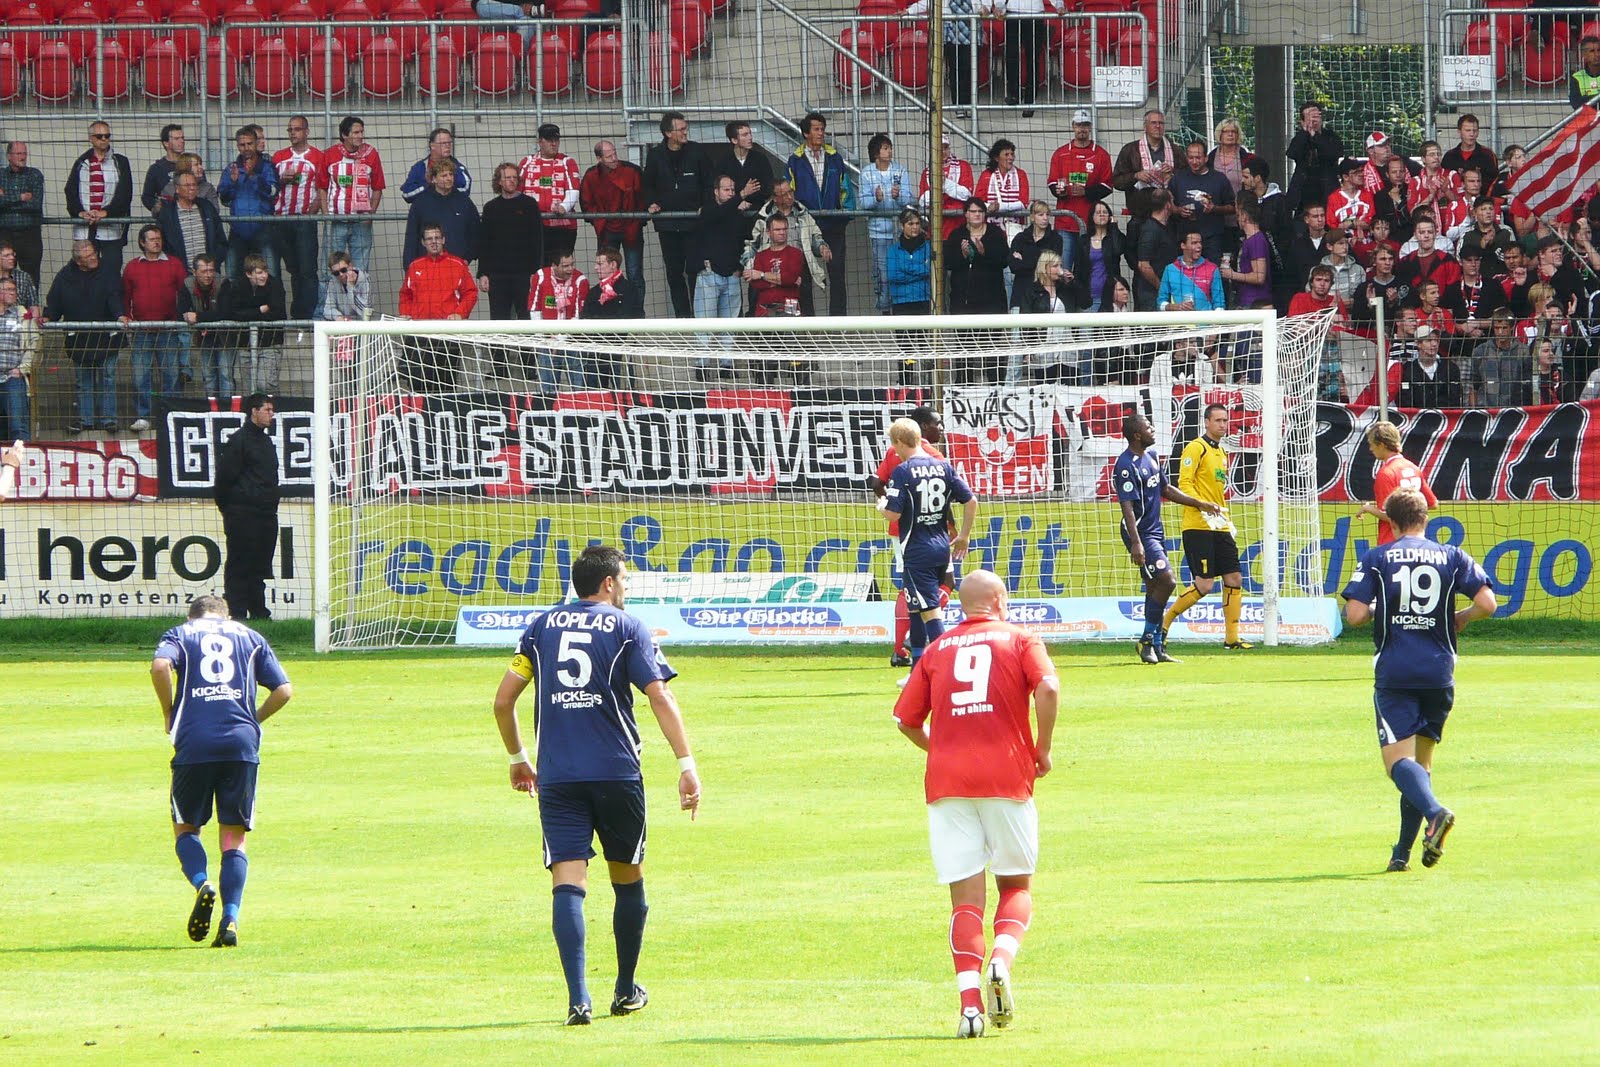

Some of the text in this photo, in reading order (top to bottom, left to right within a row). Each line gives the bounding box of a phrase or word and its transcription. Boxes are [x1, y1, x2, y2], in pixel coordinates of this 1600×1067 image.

[1096, 68, 1124, 76] BLOCK
[1106, 80, 1133, 88] PLATZ
[1470, 79, 1481, 87] 49
[167, 403, 922, 490] GEN ALLE STADIONVER
[0, 446, 139, 499] BERG
[910, 465, 946, 479] HAAS
[955, 461, 1048, 495] AHLEN
[916, 477, 946, 514] 18
[38, 527, 294, 582] herol
[1386, 548, 1448, 566] FELDHAHN
[1200, 558, 1208, 574] 1
[1391, 565, 1442, 614] 19
[38, 590, 194, 608] Kompetenz
[477, 612, 523, 630] Die
[694, 608, 829, 626] Die Glocke
[1180, 604, 1266, 624] Gloke
[1391, 614, 1437, 627] KICKERS
[1071, 622, 1096, 633] Tages
[199, 633, 235, 684] 8
[556, 630, 593, 688] 5
[950, 643, 993, 706] 9
[191, 684, 243, 700] KICKERS
[551, 690, 603, 705] KICKERS
[951, 703, 994, 717] rw ahlen
